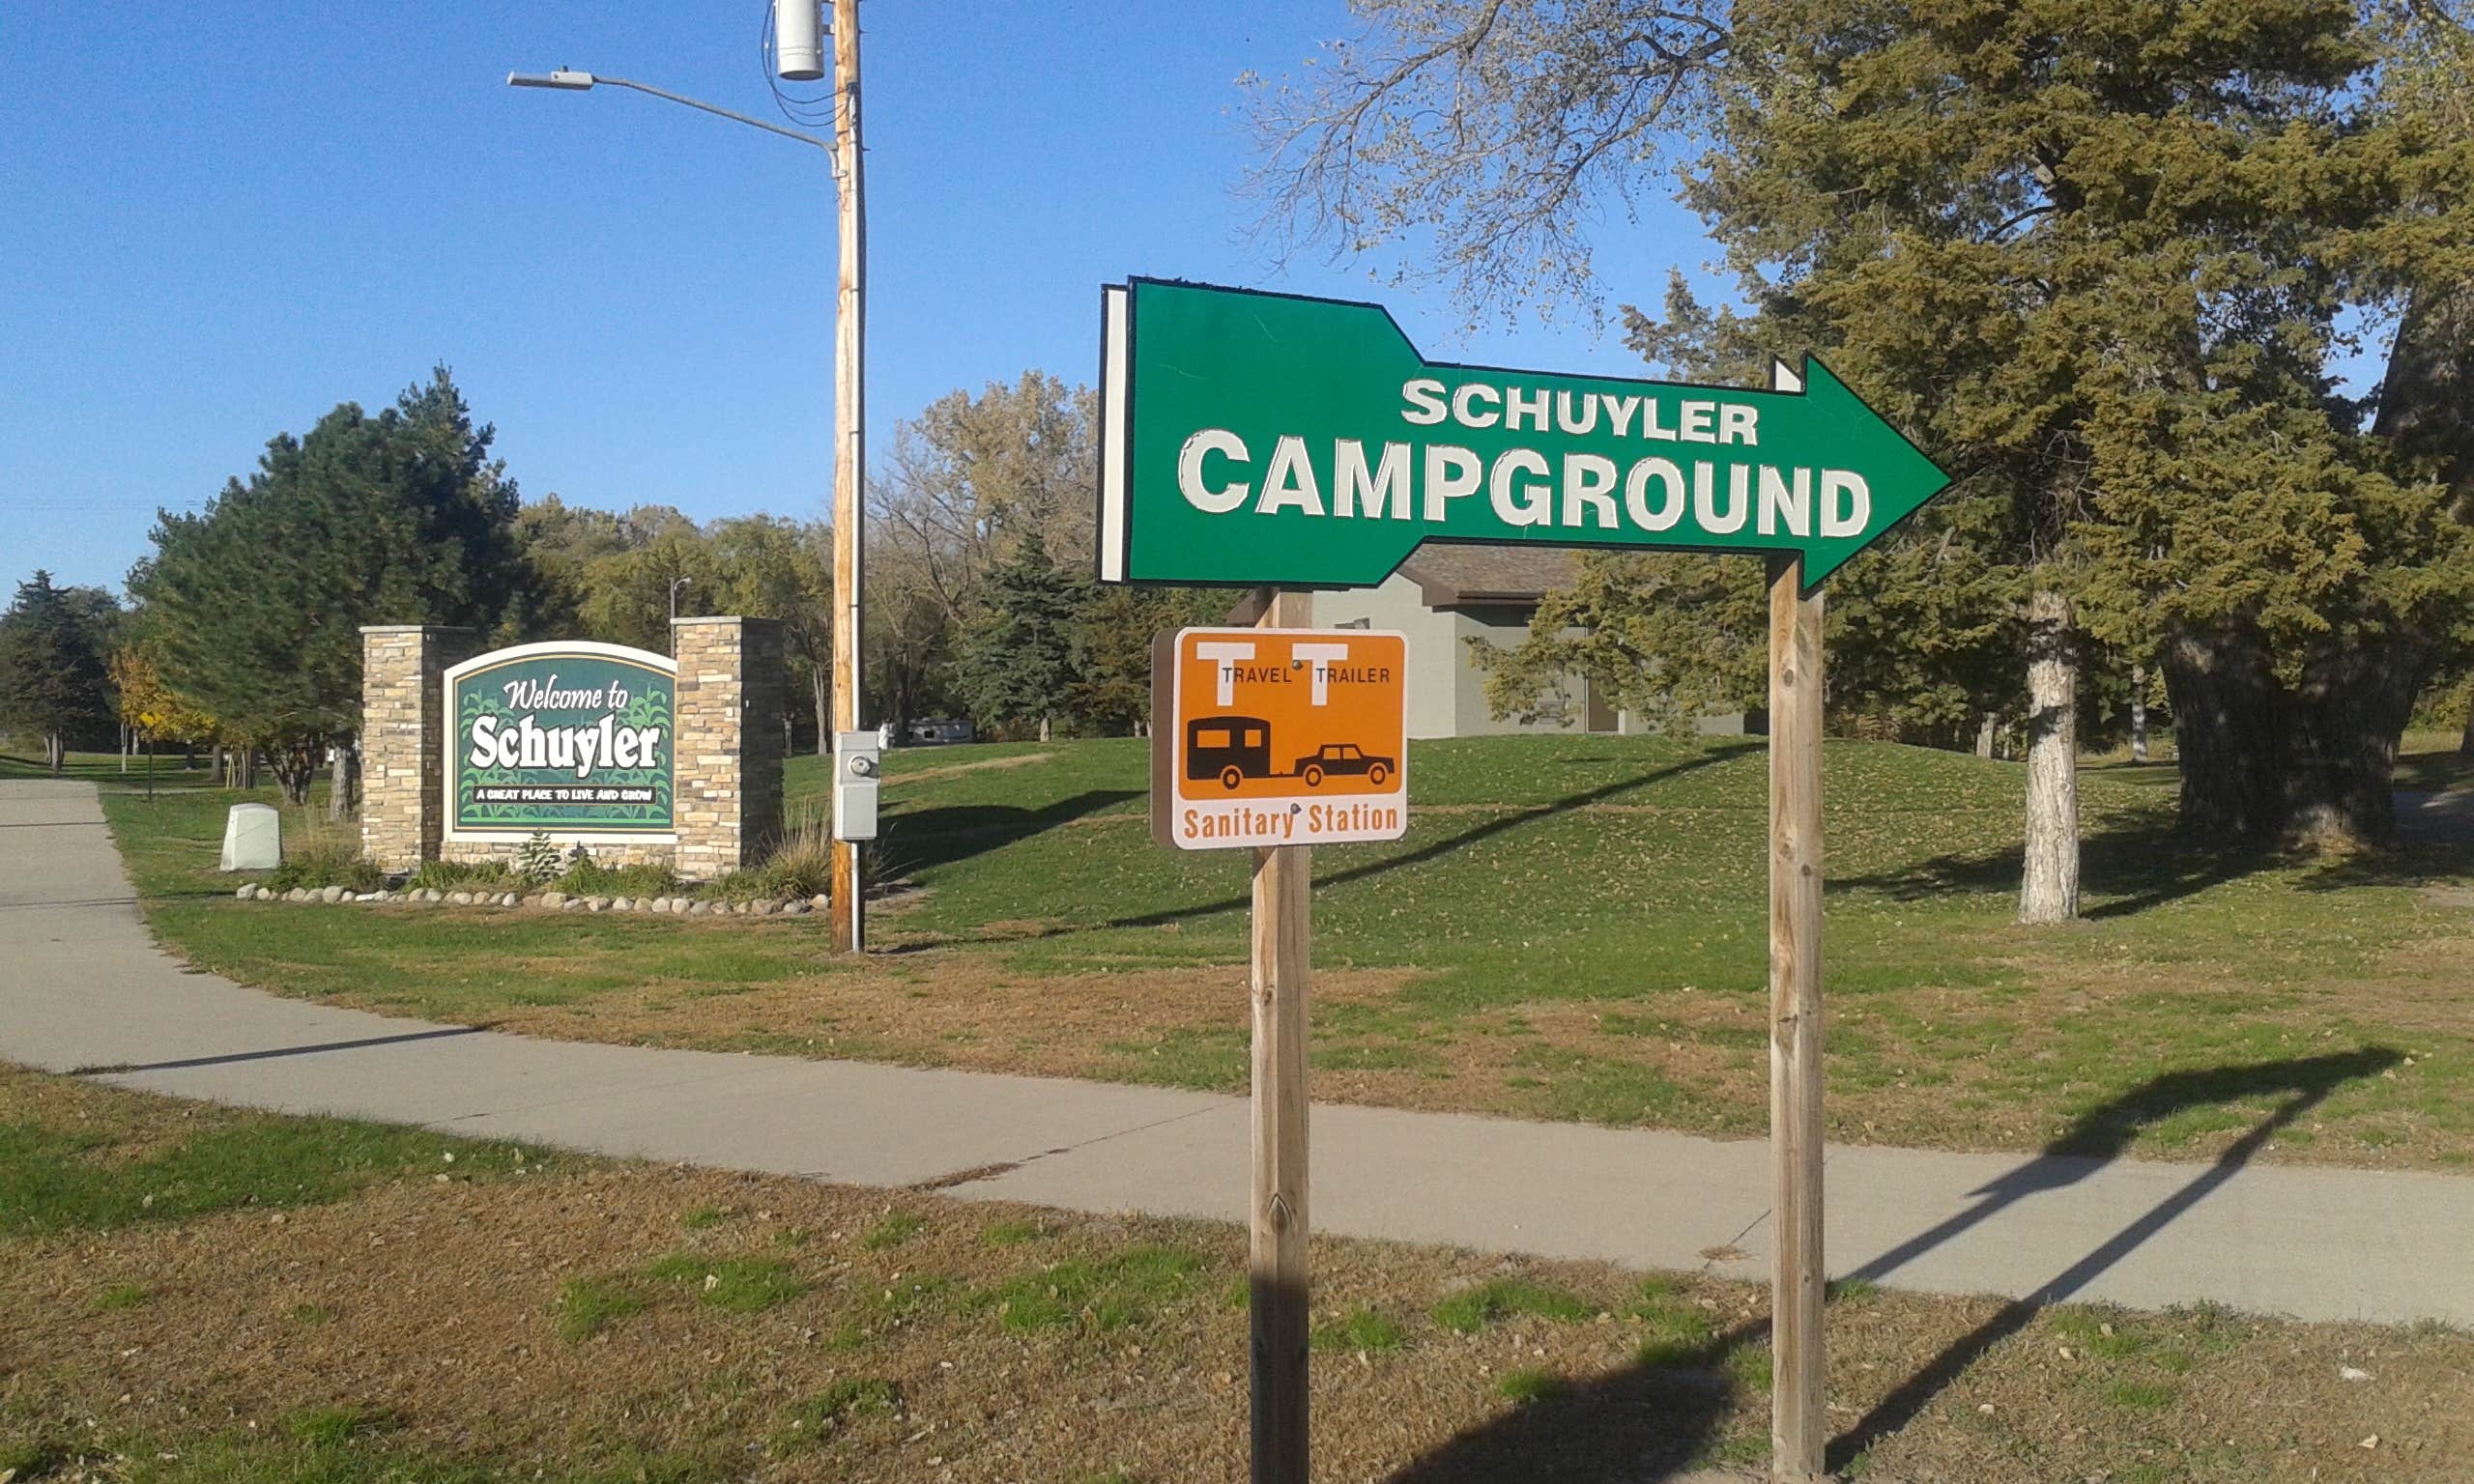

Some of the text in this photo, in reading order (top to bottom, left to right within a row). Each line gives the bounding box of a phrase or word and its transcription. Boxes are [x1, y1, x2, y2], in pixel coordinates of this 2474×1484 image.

[1400, 377, 1759, 446] SCHUYLER
[1177, 428, 1872, 540] CAMPGROUND
[503, 674, 628, 710] Welcome to
[1222, 667, 1391, 684] TRAVEL TRAILER
[469, 711, 661, 779] Schuyler
[476, 788, 652, 801] A GREAT PLACE TO LIVE AND GROW
[1183, 803, 1398, 840] Sanitary Station
